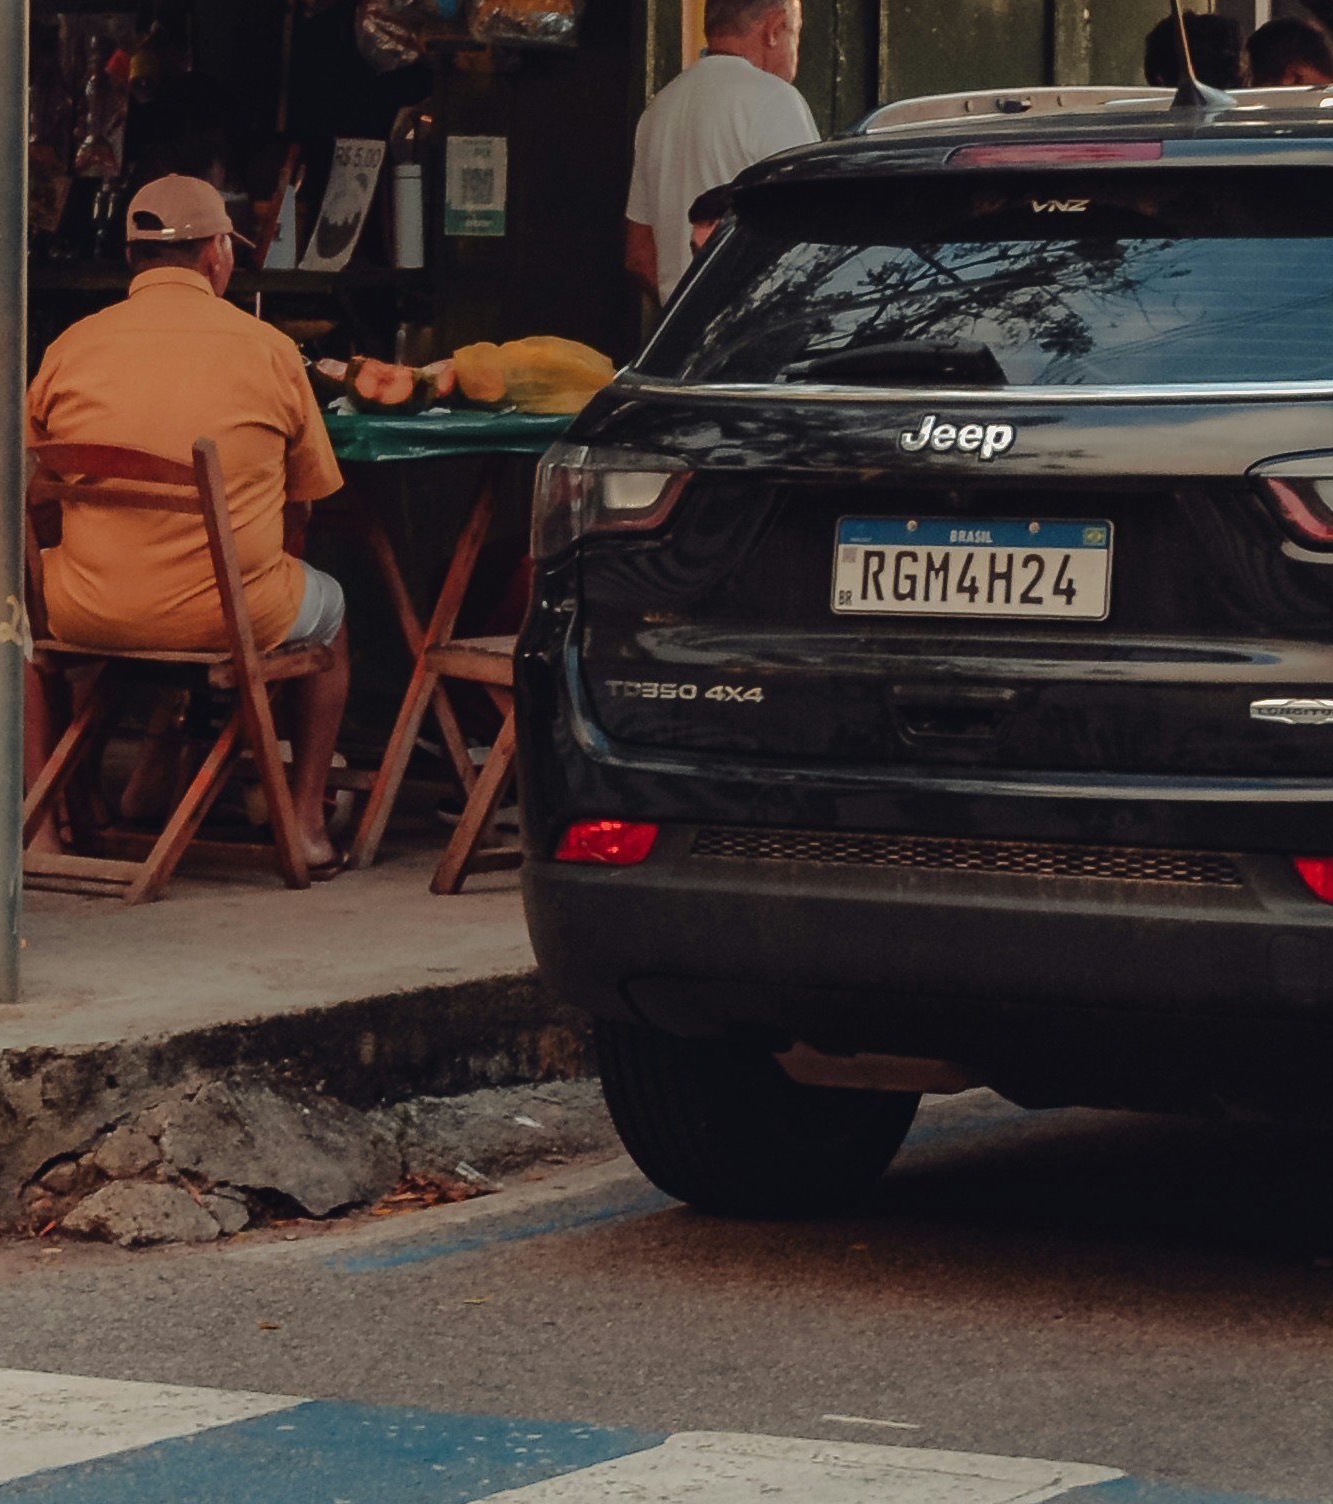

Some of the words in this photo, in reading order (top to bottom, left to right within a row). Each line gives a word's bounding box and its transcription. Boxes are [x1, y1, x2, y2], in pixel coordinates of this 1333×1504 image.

[900, 414, 1015, 459] Jeep
[950, 529, 993, 544] BRASIL
[860, 550, 1077, 605] RGM4H24
[838, 589, 853, 606] BR
[604, 679, 698, 700] TD350
[704, 684, 765, 704] 4X4
[1257, 708, 1333, 717] LONGITU
